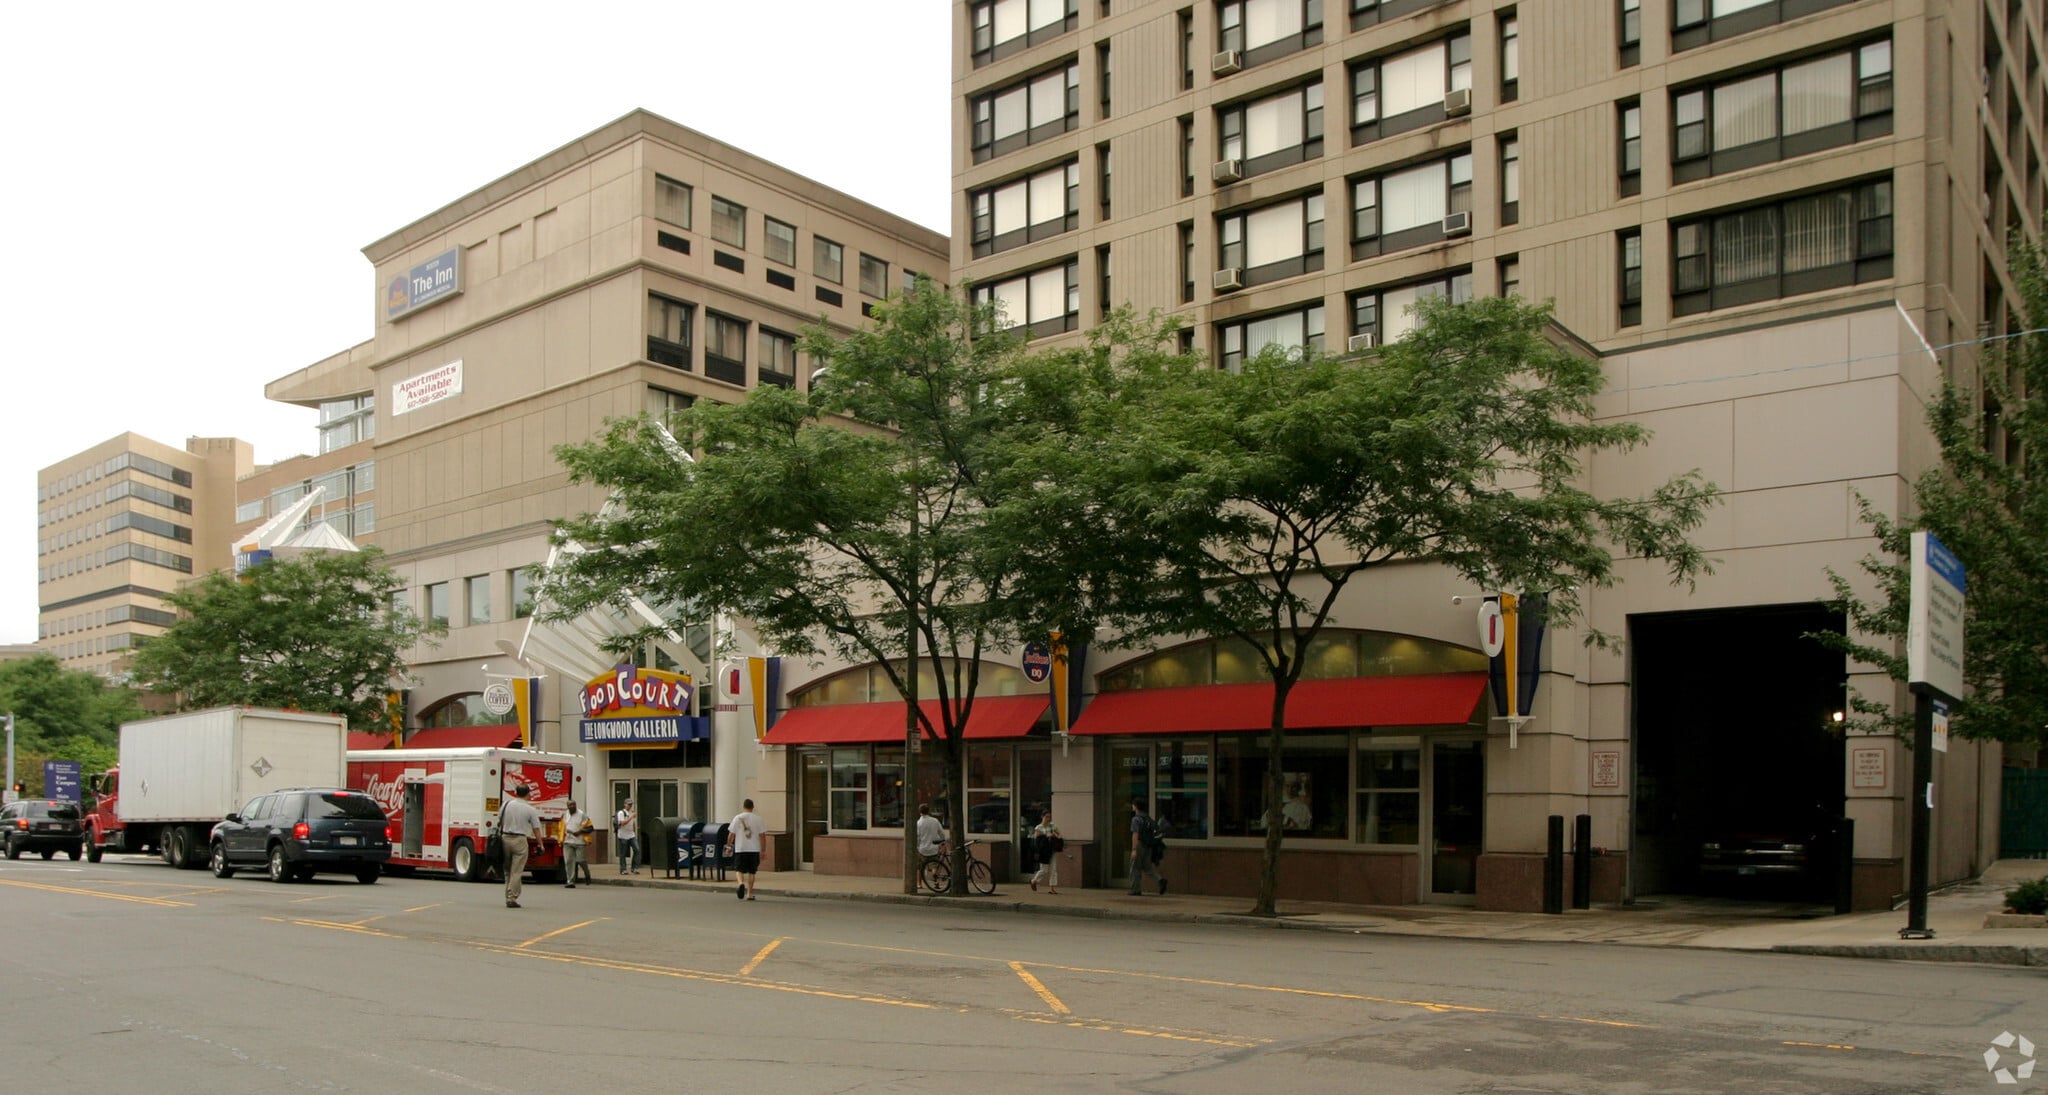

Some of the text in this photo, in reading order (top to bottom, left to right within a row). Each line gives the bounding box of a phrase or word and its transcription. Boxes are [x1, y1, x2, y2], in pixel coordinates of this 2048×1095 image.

[413, 267, 453, 296] The Inn
[399, 365, 456, 393] Apartments
[407, 378, 452, 400] Available
[1031, 668, 1042, 679] DQ
[489, 696, 509, 705] COFFEE
[617, 671, 689, 708] COURT
[585, 719, 679, 739] THE LONGWOOD GALLERIA
